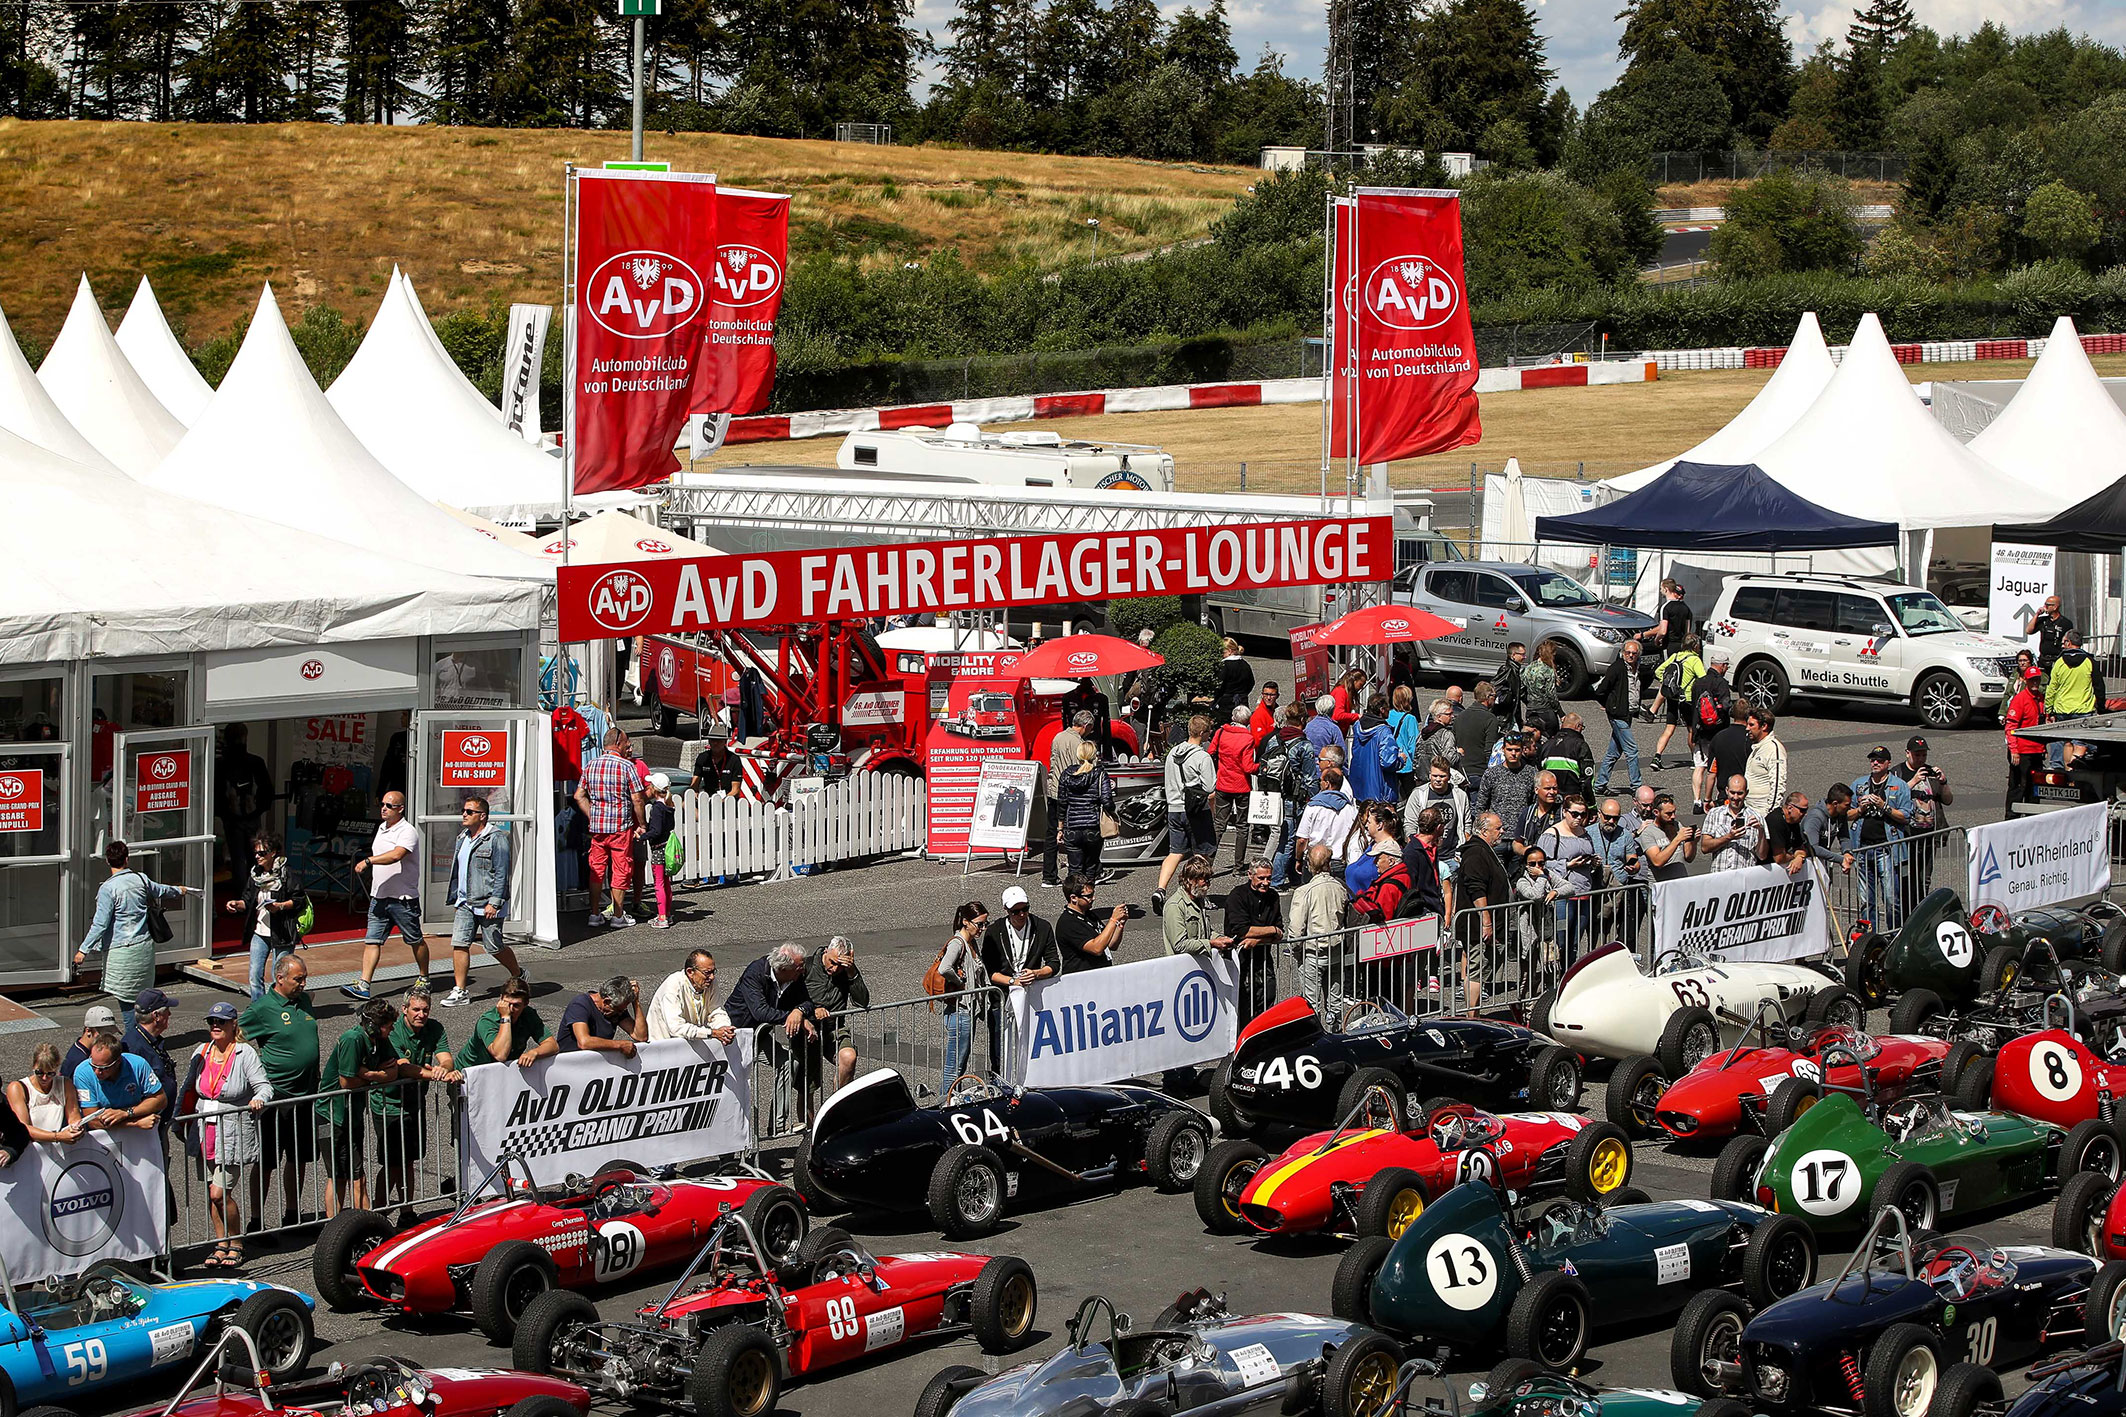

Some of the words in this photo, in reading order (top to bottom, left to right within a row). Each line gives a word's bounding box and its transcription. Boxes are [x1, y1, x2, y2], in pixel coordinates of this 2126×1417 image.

[600, 276, 694, 328] AvD
[1377, 278, 1451, 320] AvD
[1371, 344, 1462, 360] Automobilclub
[591, 358, 688, 373] Automobilclub
[1366, 366, 1389, 378] von
[1394, 360, 1470, 378] Deutschland
[584, 380, 608, 394] von
[612, 375, 688, 392] Deutschland
[671, 560, 777, 626] AvD
[801, 522, 1371, 616] FAHRERLAGER-LOUNGE
[1996, 576, 2048, 596] Jaguar
[596, 585, 649, 622] AvD
[1437, 636, 1472, 646] Service
[302, 664, 322, 678] AvD
[928, 656, 996, 667] MOBILITY
[961, 667, 994, 676] MORE
[1800, 668, 1840, 684] Media
[1842, 672, 1889, 688] Shuttle
[464, 697, 503, 706] OLDTIMER
[306, 718, 365, 744] SALE
[464, 742, 489, 754] AvD
[154, 762, 175, 777] AvD
[452, 769, 496, 778] FAN-SHOP
[147, 800, 179, 809] RENNPULLI
[150, 791, 176, 800] AUSGABE
[2038, 788, 2049, 796] HA
[2053, 788, 2064, 797] TK
[2065, 788, 2079, 798] 101
[1121, 836, 1154, 845] EINSTEIGEN.
[2009, 880, 2037, 894] Genau.
[2040, 871, 2070, 888] Richtig.
[1680, 900, 1718, 930] AvD
[1723, 880, 1814, 926] OLDTIMER
[1374, 922, 1416, 956] EXIT
[1717, 921, 1761, 948] GRAND
[1763, 916, 1790, 940] PRIX
[1941, 931, 1968, 957] 27
[1672, 979, 1710, 1008] 63
[1031, 1000, 1165, 1060] Allianz
[2043, 1050, 2068, 1089] 8
[505, 1084, 571, 1127] AvD
[578, 1060, 728, 1116] OLDTIMER
[1232, 1084, 1256, 1092] CHICAGO
[568, 1115, 636, 1148] GRAND
[638, 1106, 689, 1137] PRIX
[950, 1108, 1010, 1145] 64
[1798, 1160, 1848, 1203] 17
[54, 1192, 110, 1213] VOLVO
[600, 1230, 636, 1274] 181
[1435, 1246, 1488, 1290] 13
[826, 1296, 859, 1340] 89
[1963, 1316, 1997, 1366] 30
[63, 1338, 108, 1386] 59
